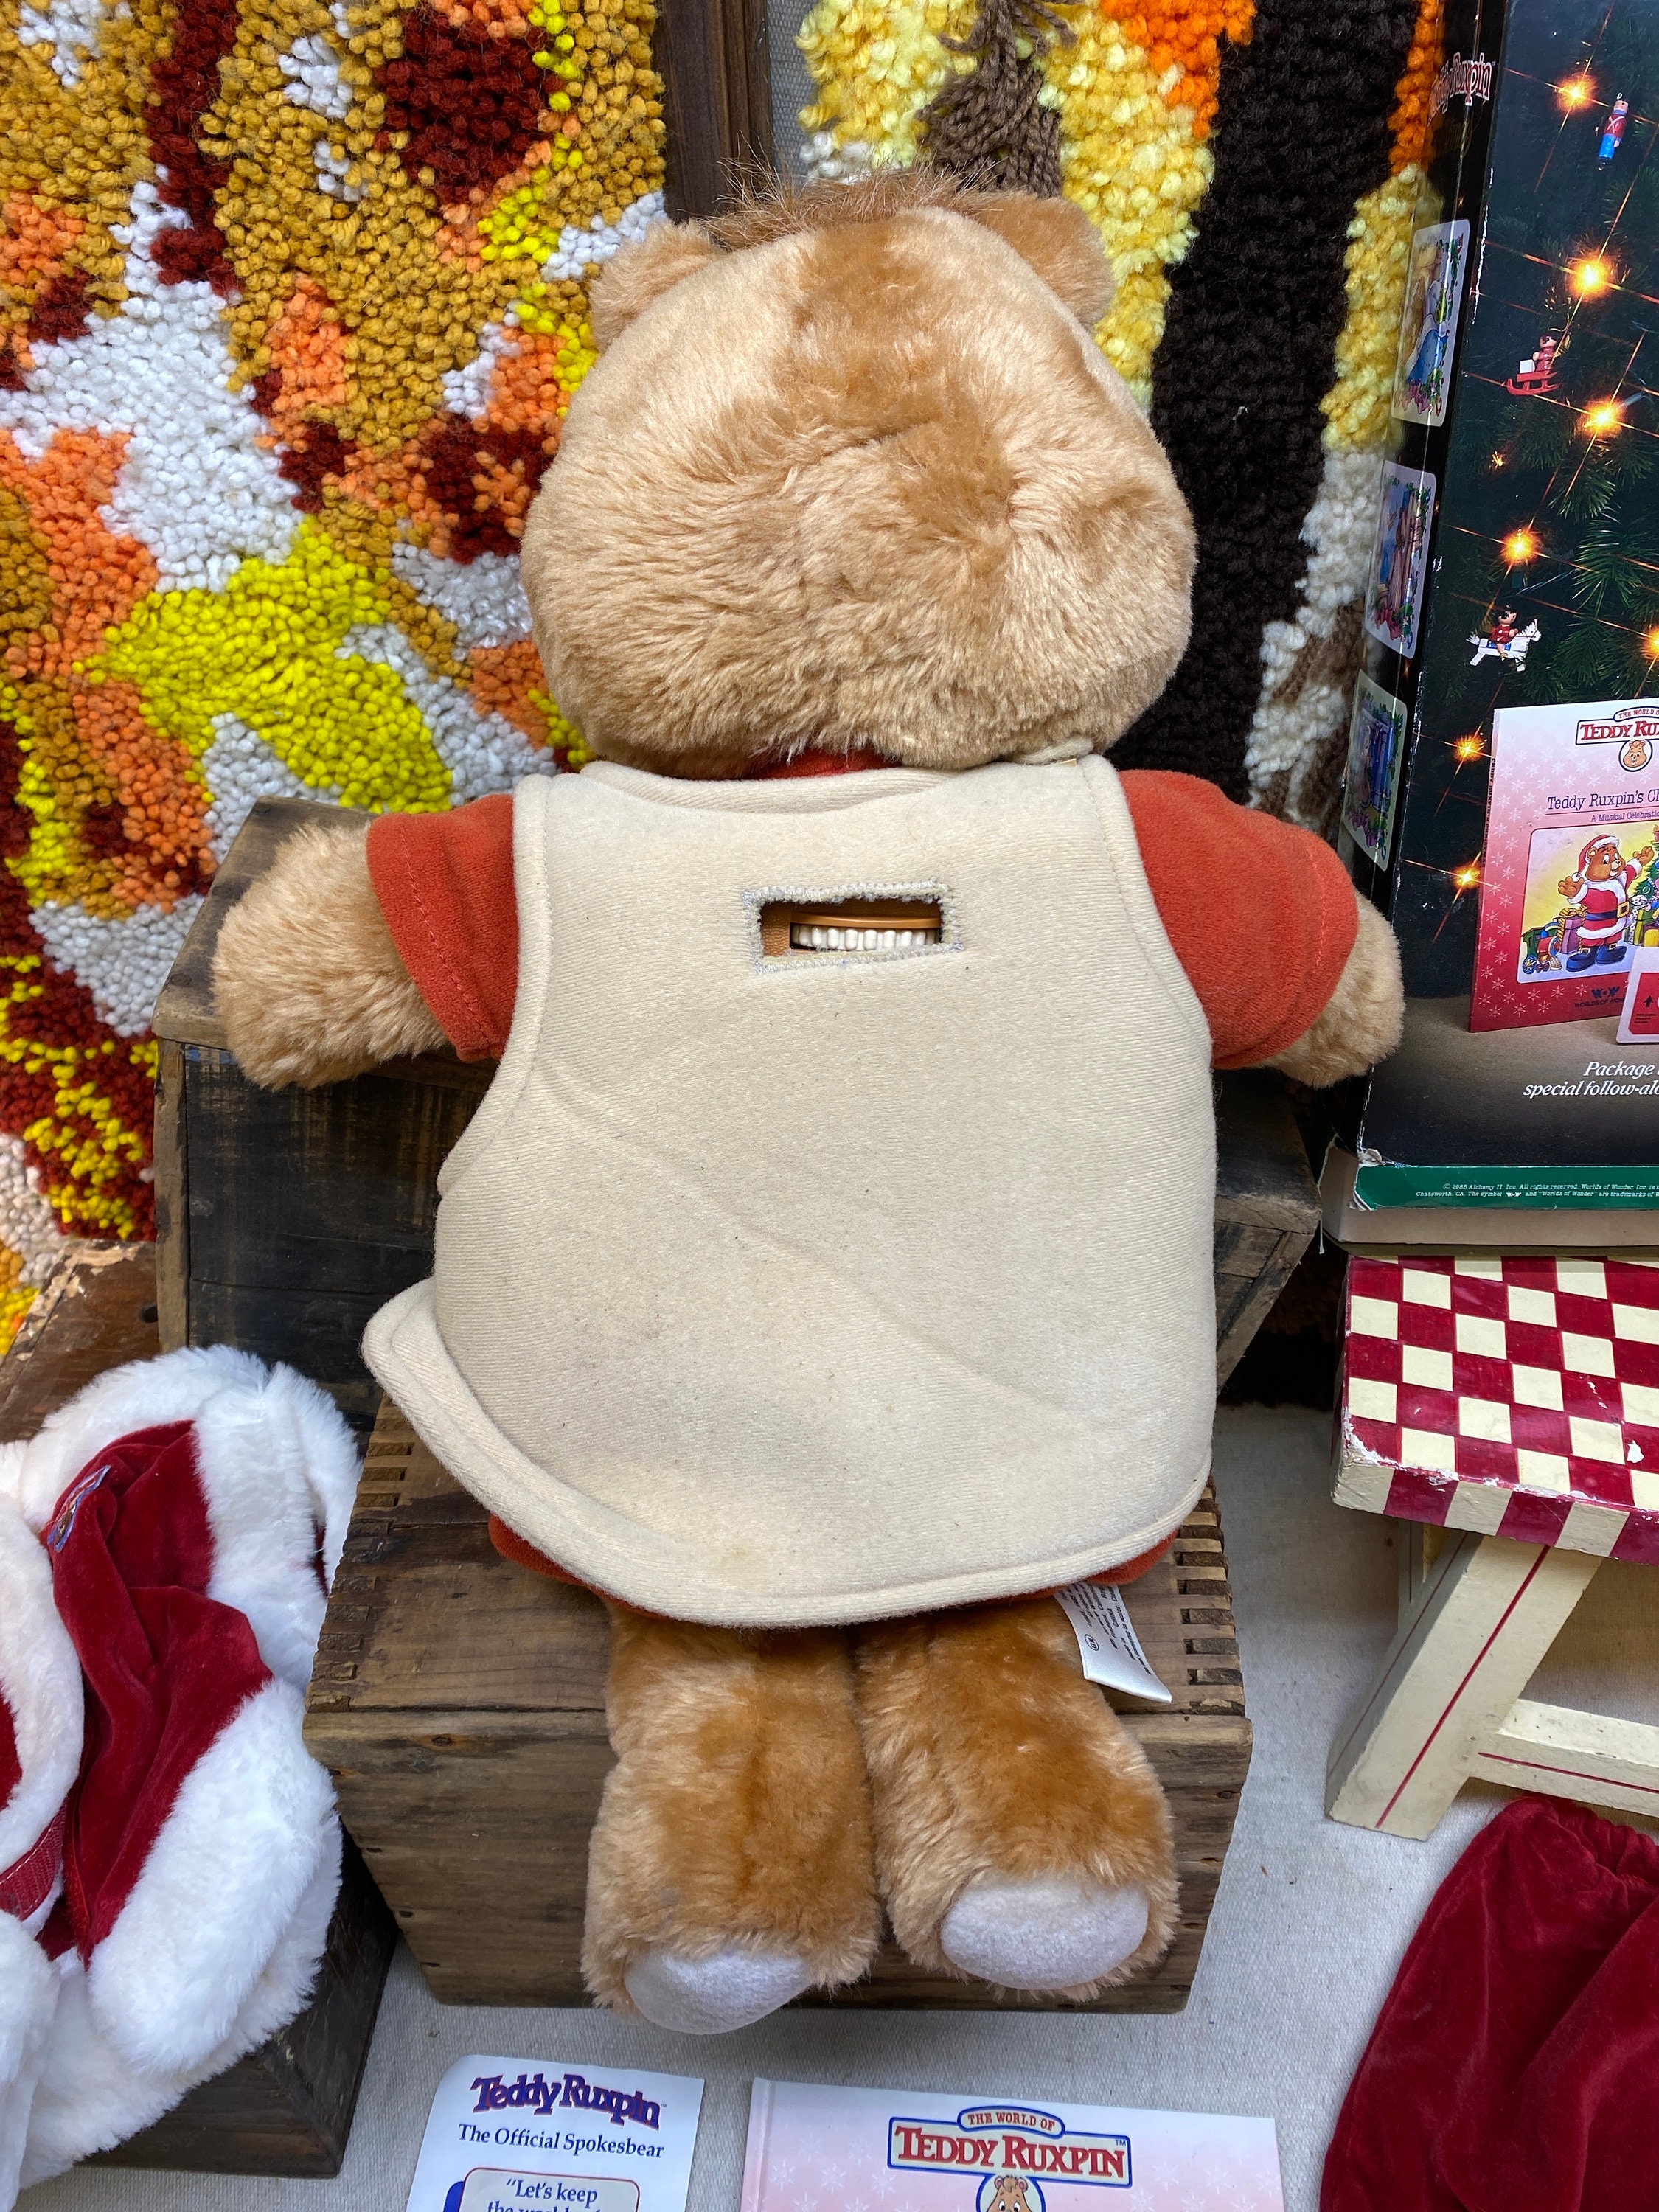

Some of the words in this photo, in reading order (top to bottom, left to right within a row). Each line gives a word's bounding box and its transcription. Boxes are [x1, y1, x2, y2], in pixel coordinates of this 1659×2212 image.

[1449, 52, 1492, 106] Ruxpin
[1618, 710, 1632, 719] THE
[1579, 723, 1633, 741] TEDDY
[1548, 795, 1586, 811] Teddy
[1589, 790, 1644, 808] Ruxpin's
[1599, 812, 1625, 822] Musical
[1583, 1061, 1655, 1079] Package
[1523, 1080, 1585, 1099] special
[1107, 1608, 1119, 1627] CHINA
[469, 2073, 562, 2115] Teddy
[558, 2073, 661, 2132] Ruxpin
[967, 2112, 992, 2125] THE
[995, 2112, 1036, 2126] WORLD
[1040, 2118, 1056, 2131] OF
[458, 2124, 490, 2143] The
[494, 2128, 560, 2150] Official
[563, 2133, 664, 2157] Spokesbear
[894, 2126, 998, 2167] TEDDY
[1001, 2135, 1125, 2178] RUXPIN
[556, 2183, 598, 2209] keep
